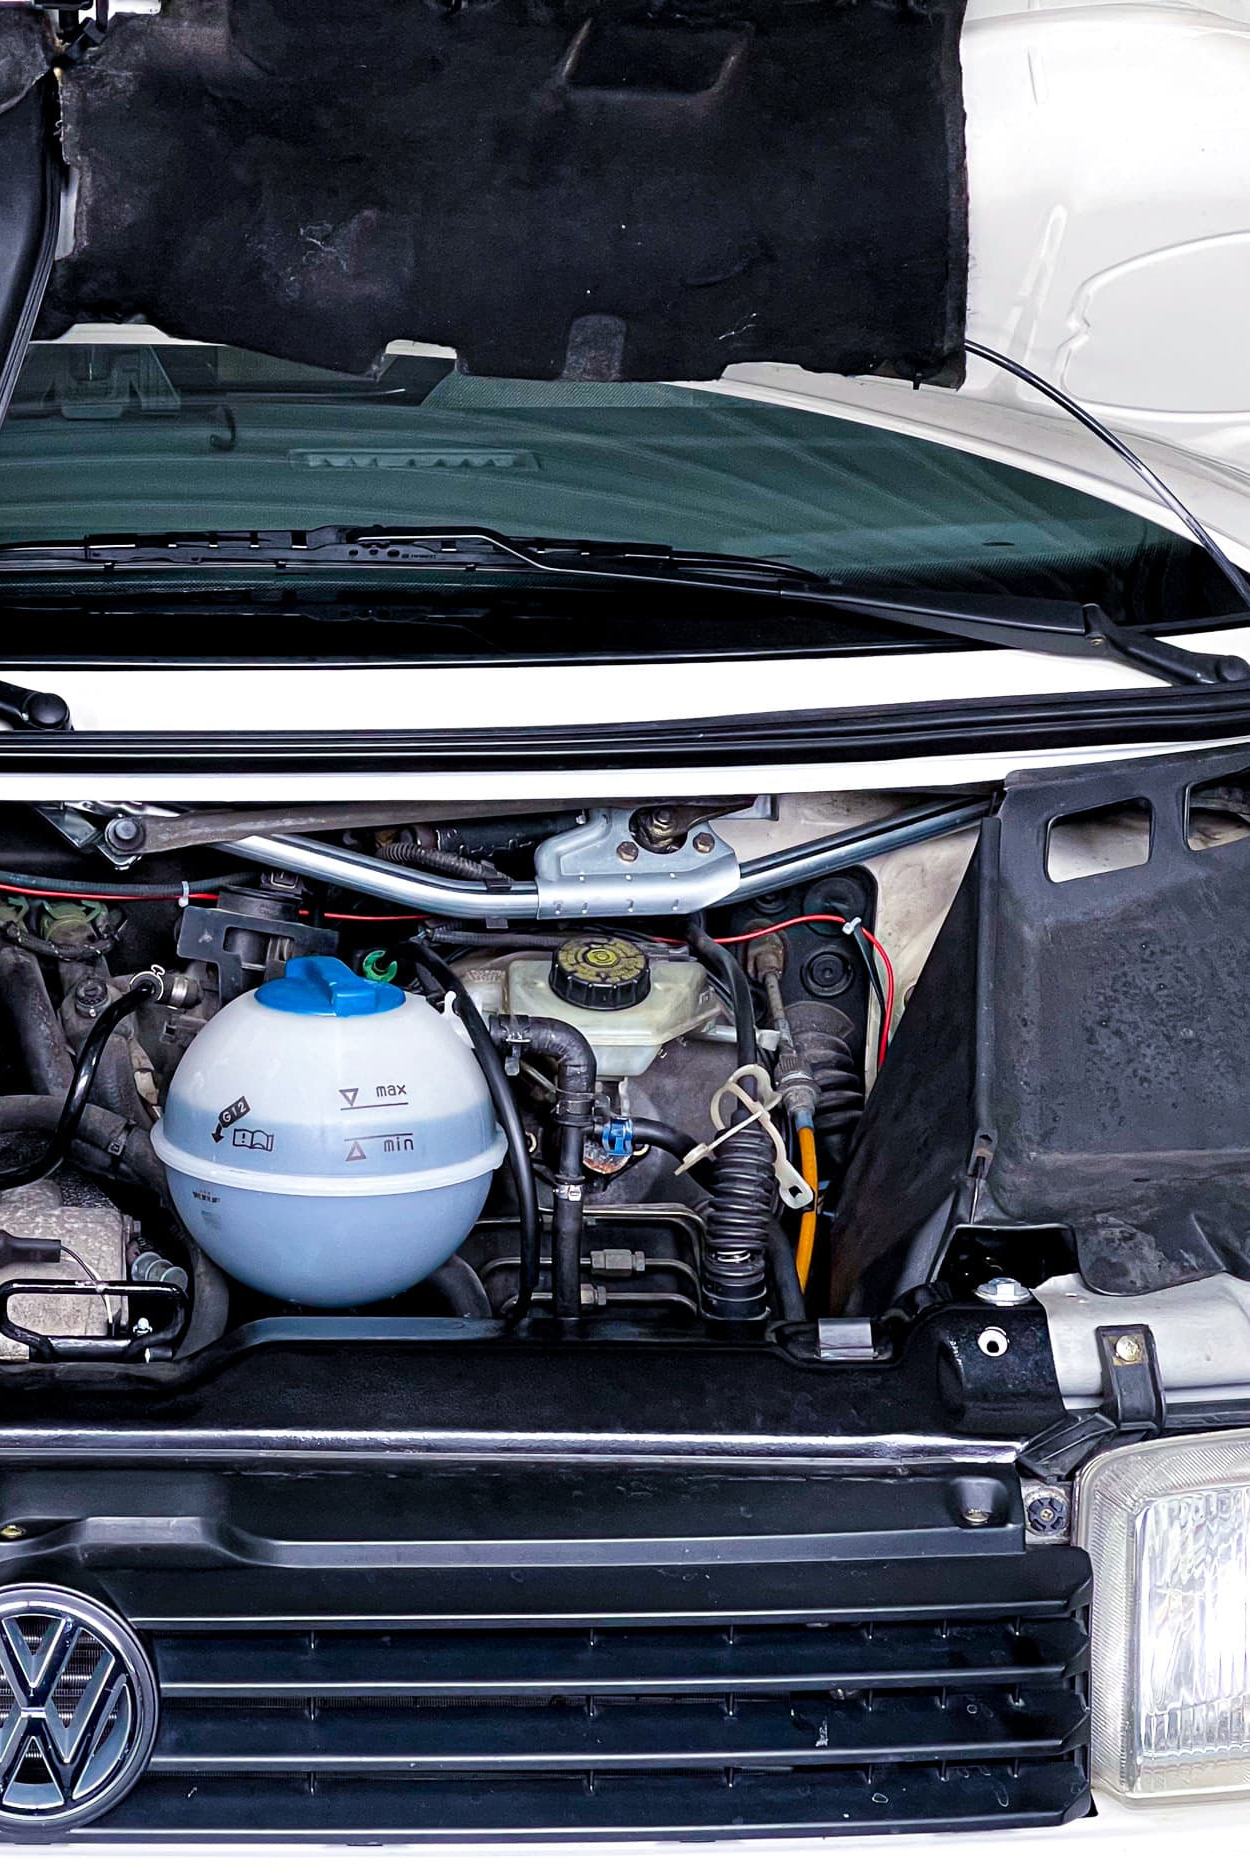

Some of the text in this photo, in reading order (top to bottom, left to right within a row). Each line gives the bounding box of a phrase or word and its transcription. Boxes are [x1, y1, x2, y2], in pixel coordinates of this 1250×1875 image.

[376, 1082, 408, 1098] max
[221, 1100, 248, 1123] G12
[383, 1135, 415, 1153] min
